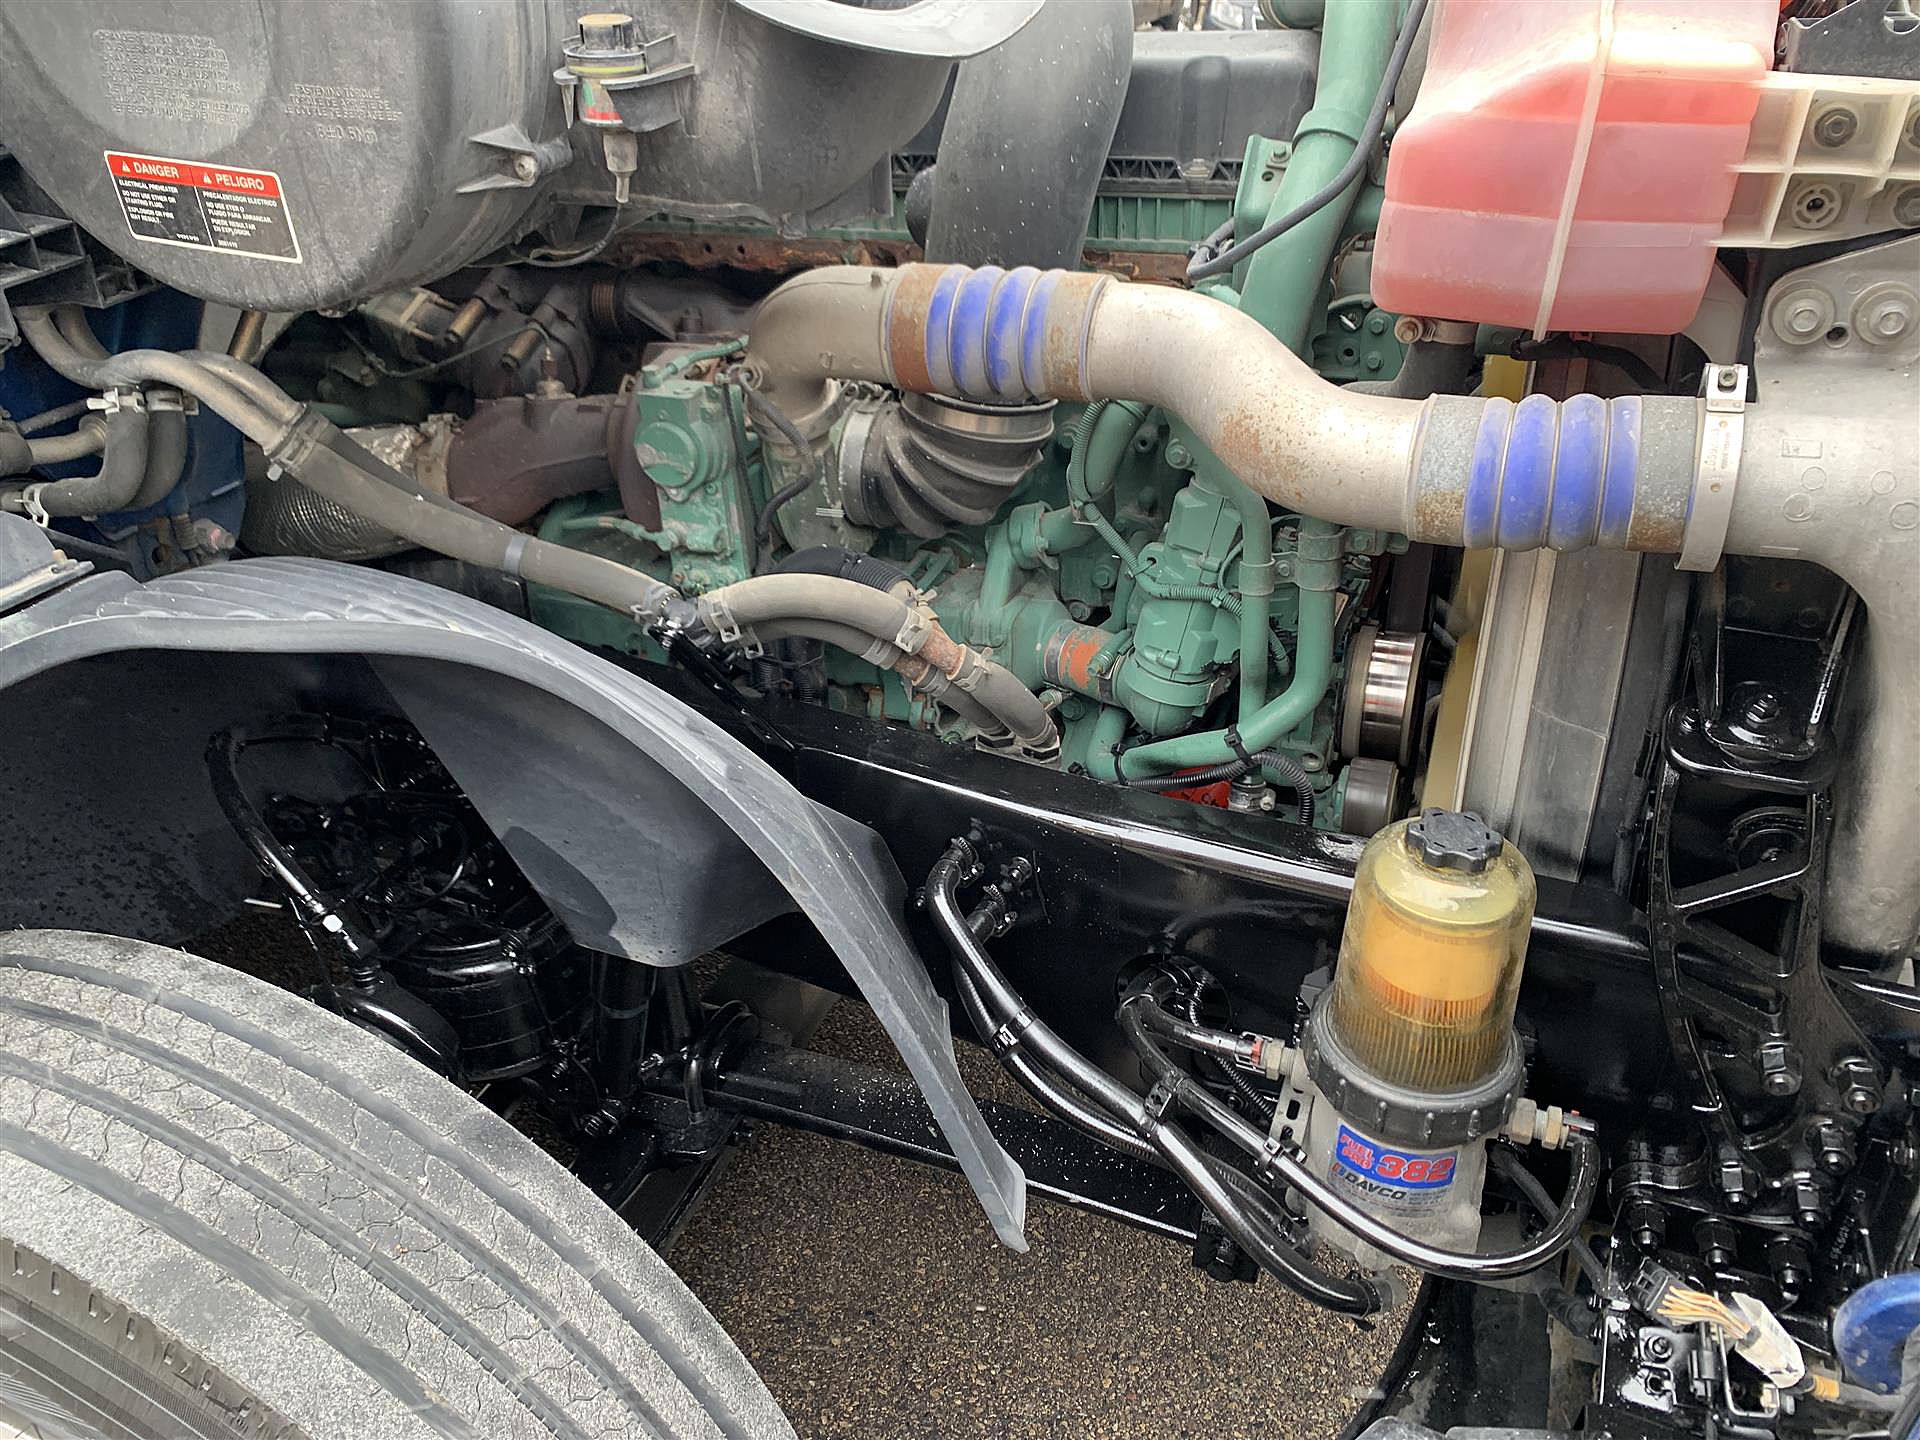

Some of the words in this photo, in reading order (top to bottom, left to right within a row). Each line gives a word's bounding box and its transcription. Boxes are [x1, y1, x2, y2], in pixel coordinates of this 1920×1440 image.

[133, 162, 179, 178] DANGER
[119, 179, 148, 189] ELECTRICAL
[149, 184, 178, 193] PREHEATER
[215, 173, 264, 191] PELIGRO
[125, 198, 148, 206] STARTING
[151, 194, 167, 202] ETHER
[203, 191, 247, 203] PRECALENTADOR
[128, 206, 155, 215] EXPLOSION
[208, 209, 226, 218] FLUIDO
[211, 218, 228, 226] PUEDE
[229, 220, 256, 230] RESULTAR
[1340, 1134, 1374, 1158] FUEL
[1342, 1146, 1373, 1169] PRO
[1376, 1155, 1455, 1183] 382
[1345, 1172, 1407, 1200] DAVCO
